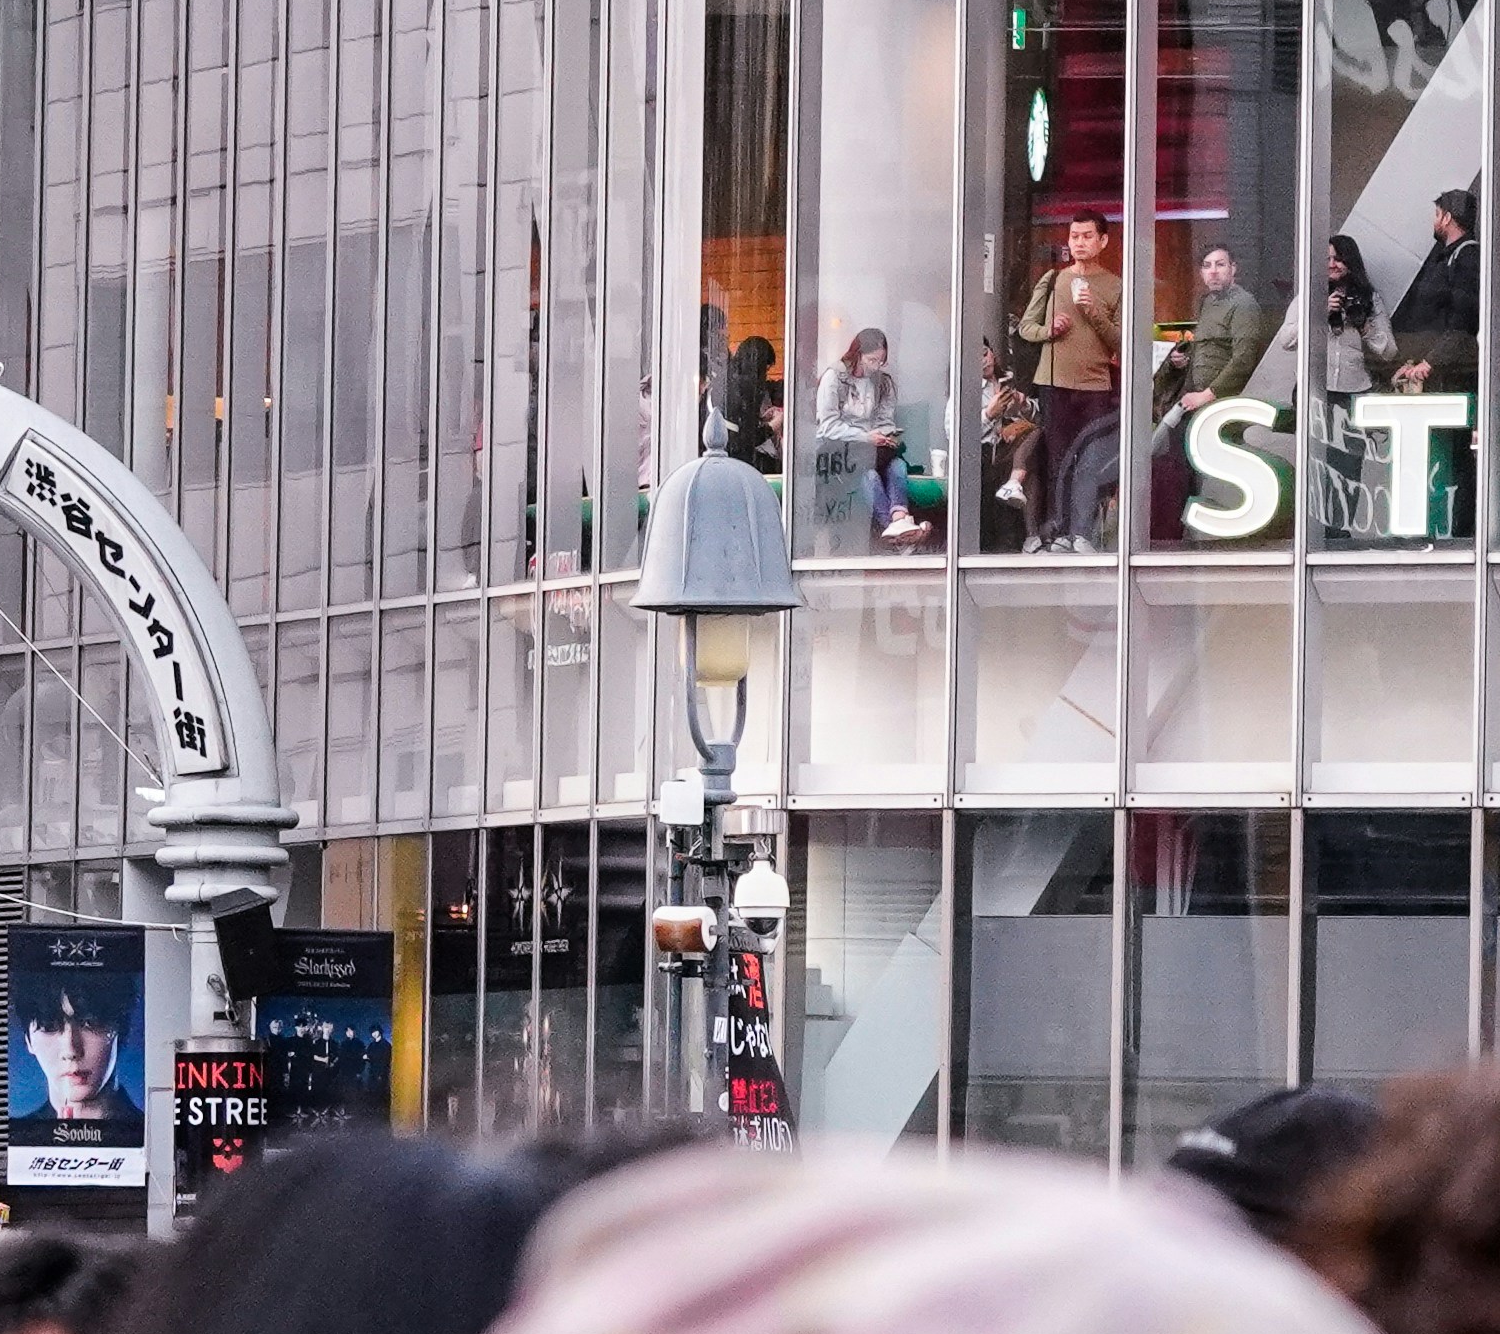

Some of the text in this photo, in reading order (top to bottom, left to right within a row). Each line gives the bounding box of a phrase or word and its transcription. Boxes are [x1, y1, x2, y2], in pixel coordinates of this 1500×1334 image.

[22, 456, 208, 759] 渋谷センター街
